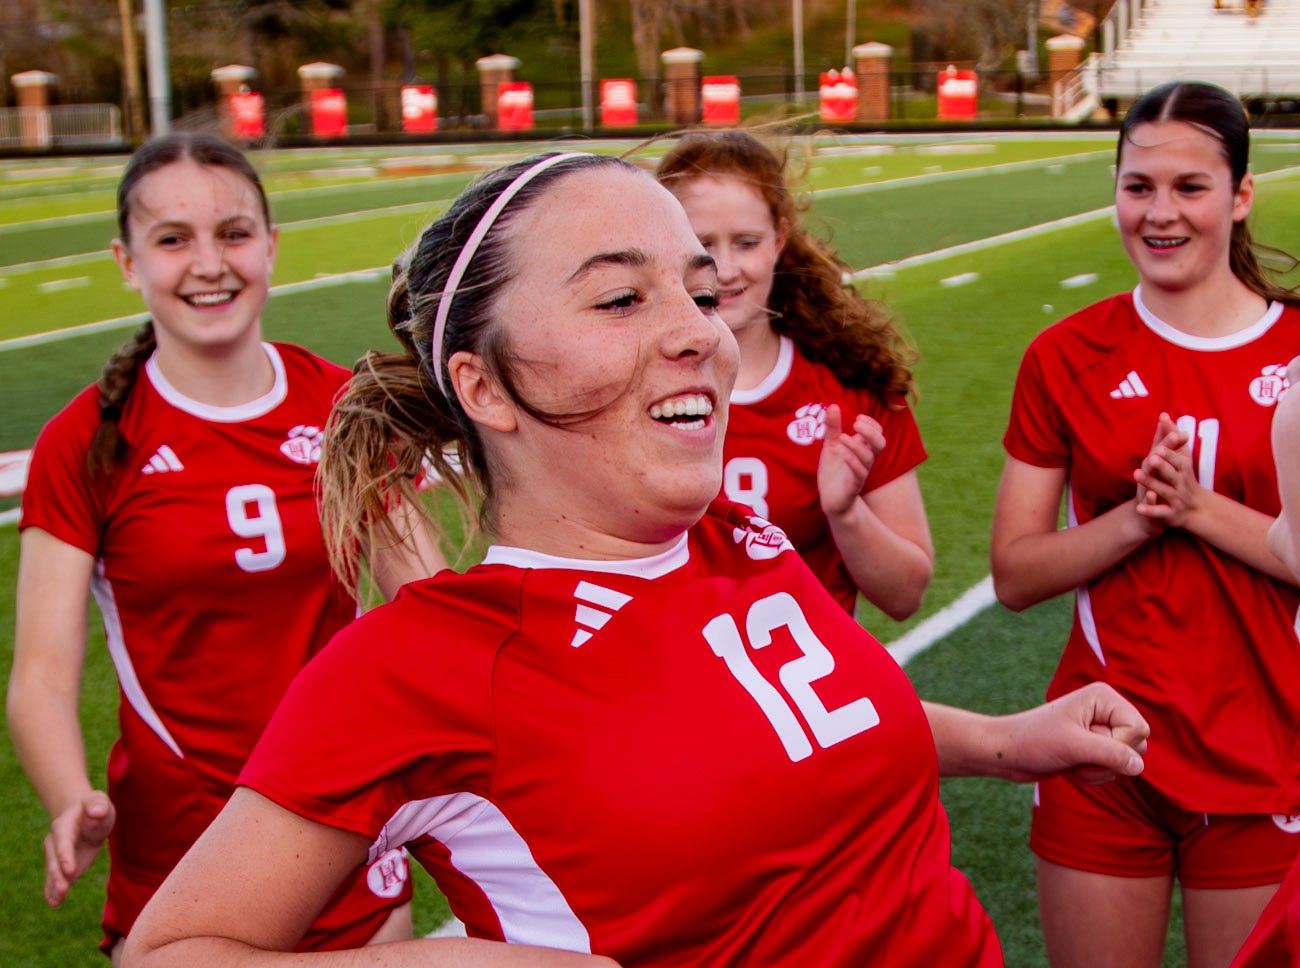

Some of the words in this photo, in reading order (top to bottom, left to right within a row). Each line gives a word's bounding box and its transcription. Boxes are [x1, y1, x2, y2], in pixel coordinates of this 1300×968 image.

[225, 484, 287, 573] 9
[724, 457, 769, 521] 8
[702, 592, 880, 762] 12
